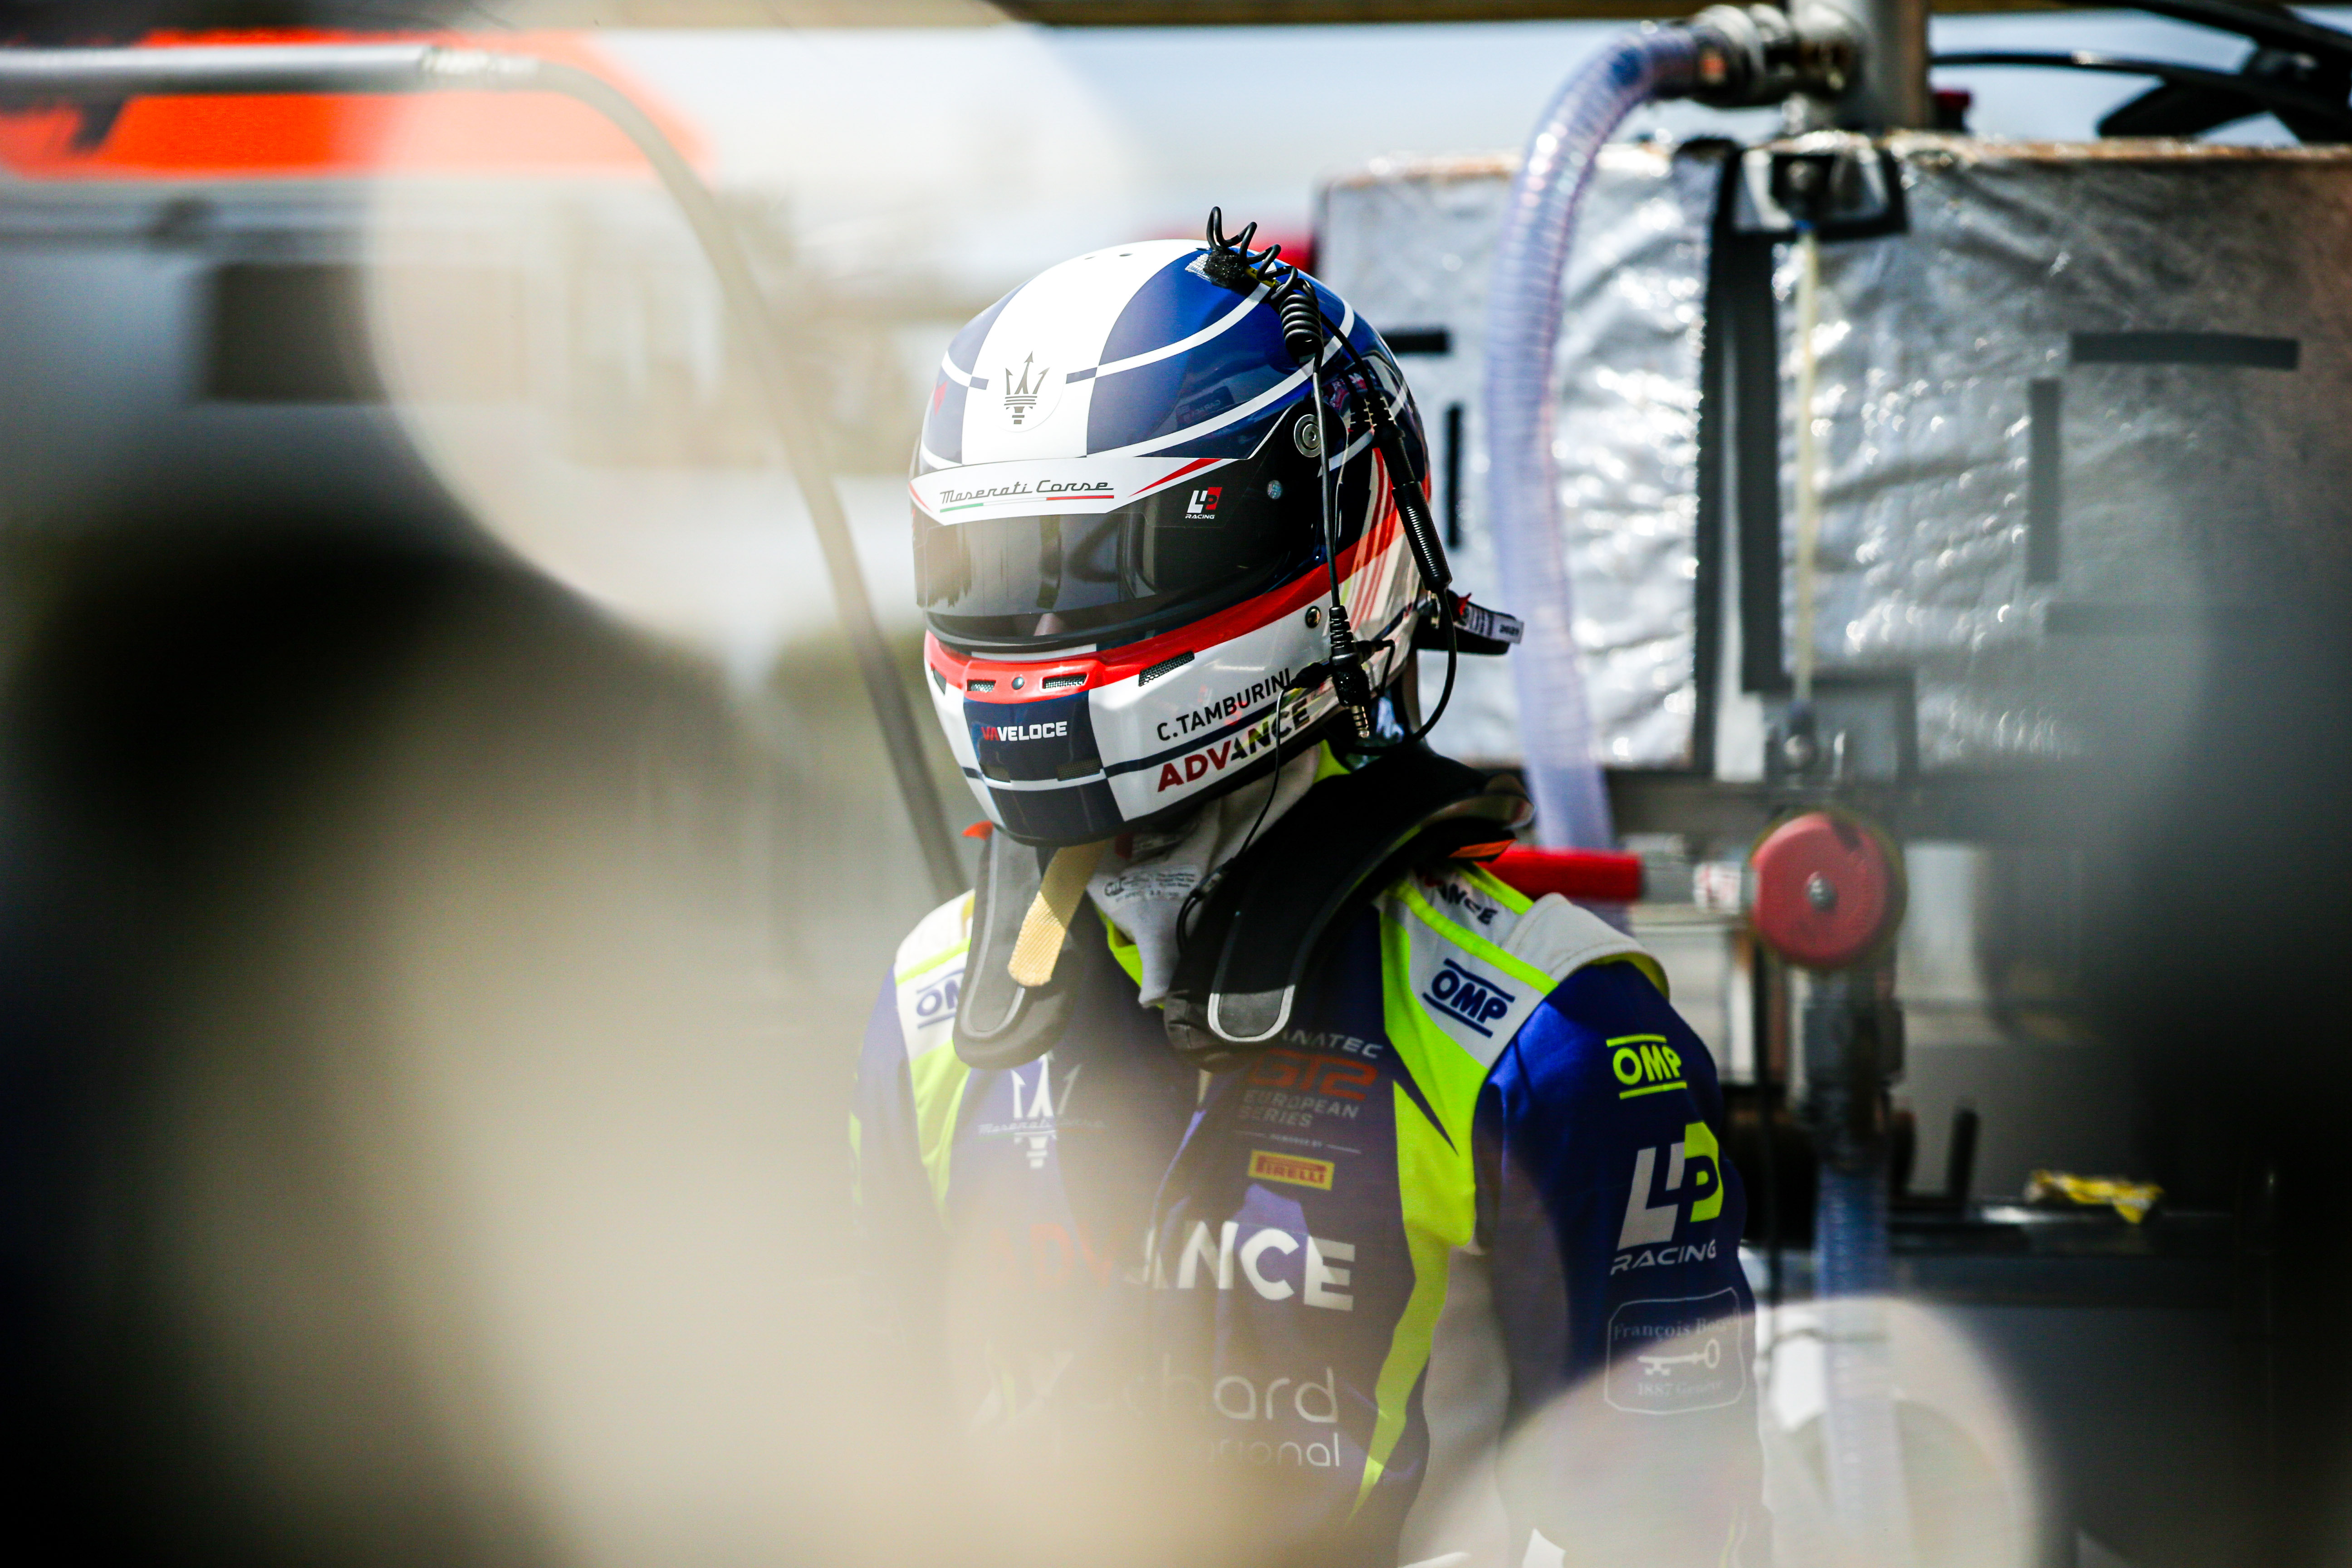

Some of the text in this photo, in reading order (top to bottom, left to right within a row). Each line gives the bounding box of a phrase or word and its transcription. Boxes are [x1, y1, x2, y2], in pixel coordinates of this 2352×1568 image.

[940, 480, 1114, 504] Maserati Corse
[1157, 698, 1310, 792] ADVANCE
[916, 979, 960, 1016] OM
[1431, 969, 1508, 1024] OMP
[1281, 1029, 1383, 1059] ANATEC
[1248, 1047, 1378, 1101] GT2
[1612, 1044, 1682, 1086] OMP
[1243, 1089, 1359, 1119] EUROPEAN
[1256, 1155, 1328, 1184] PIRELLI
[1611, 1239, 1717, 1276] RACING
